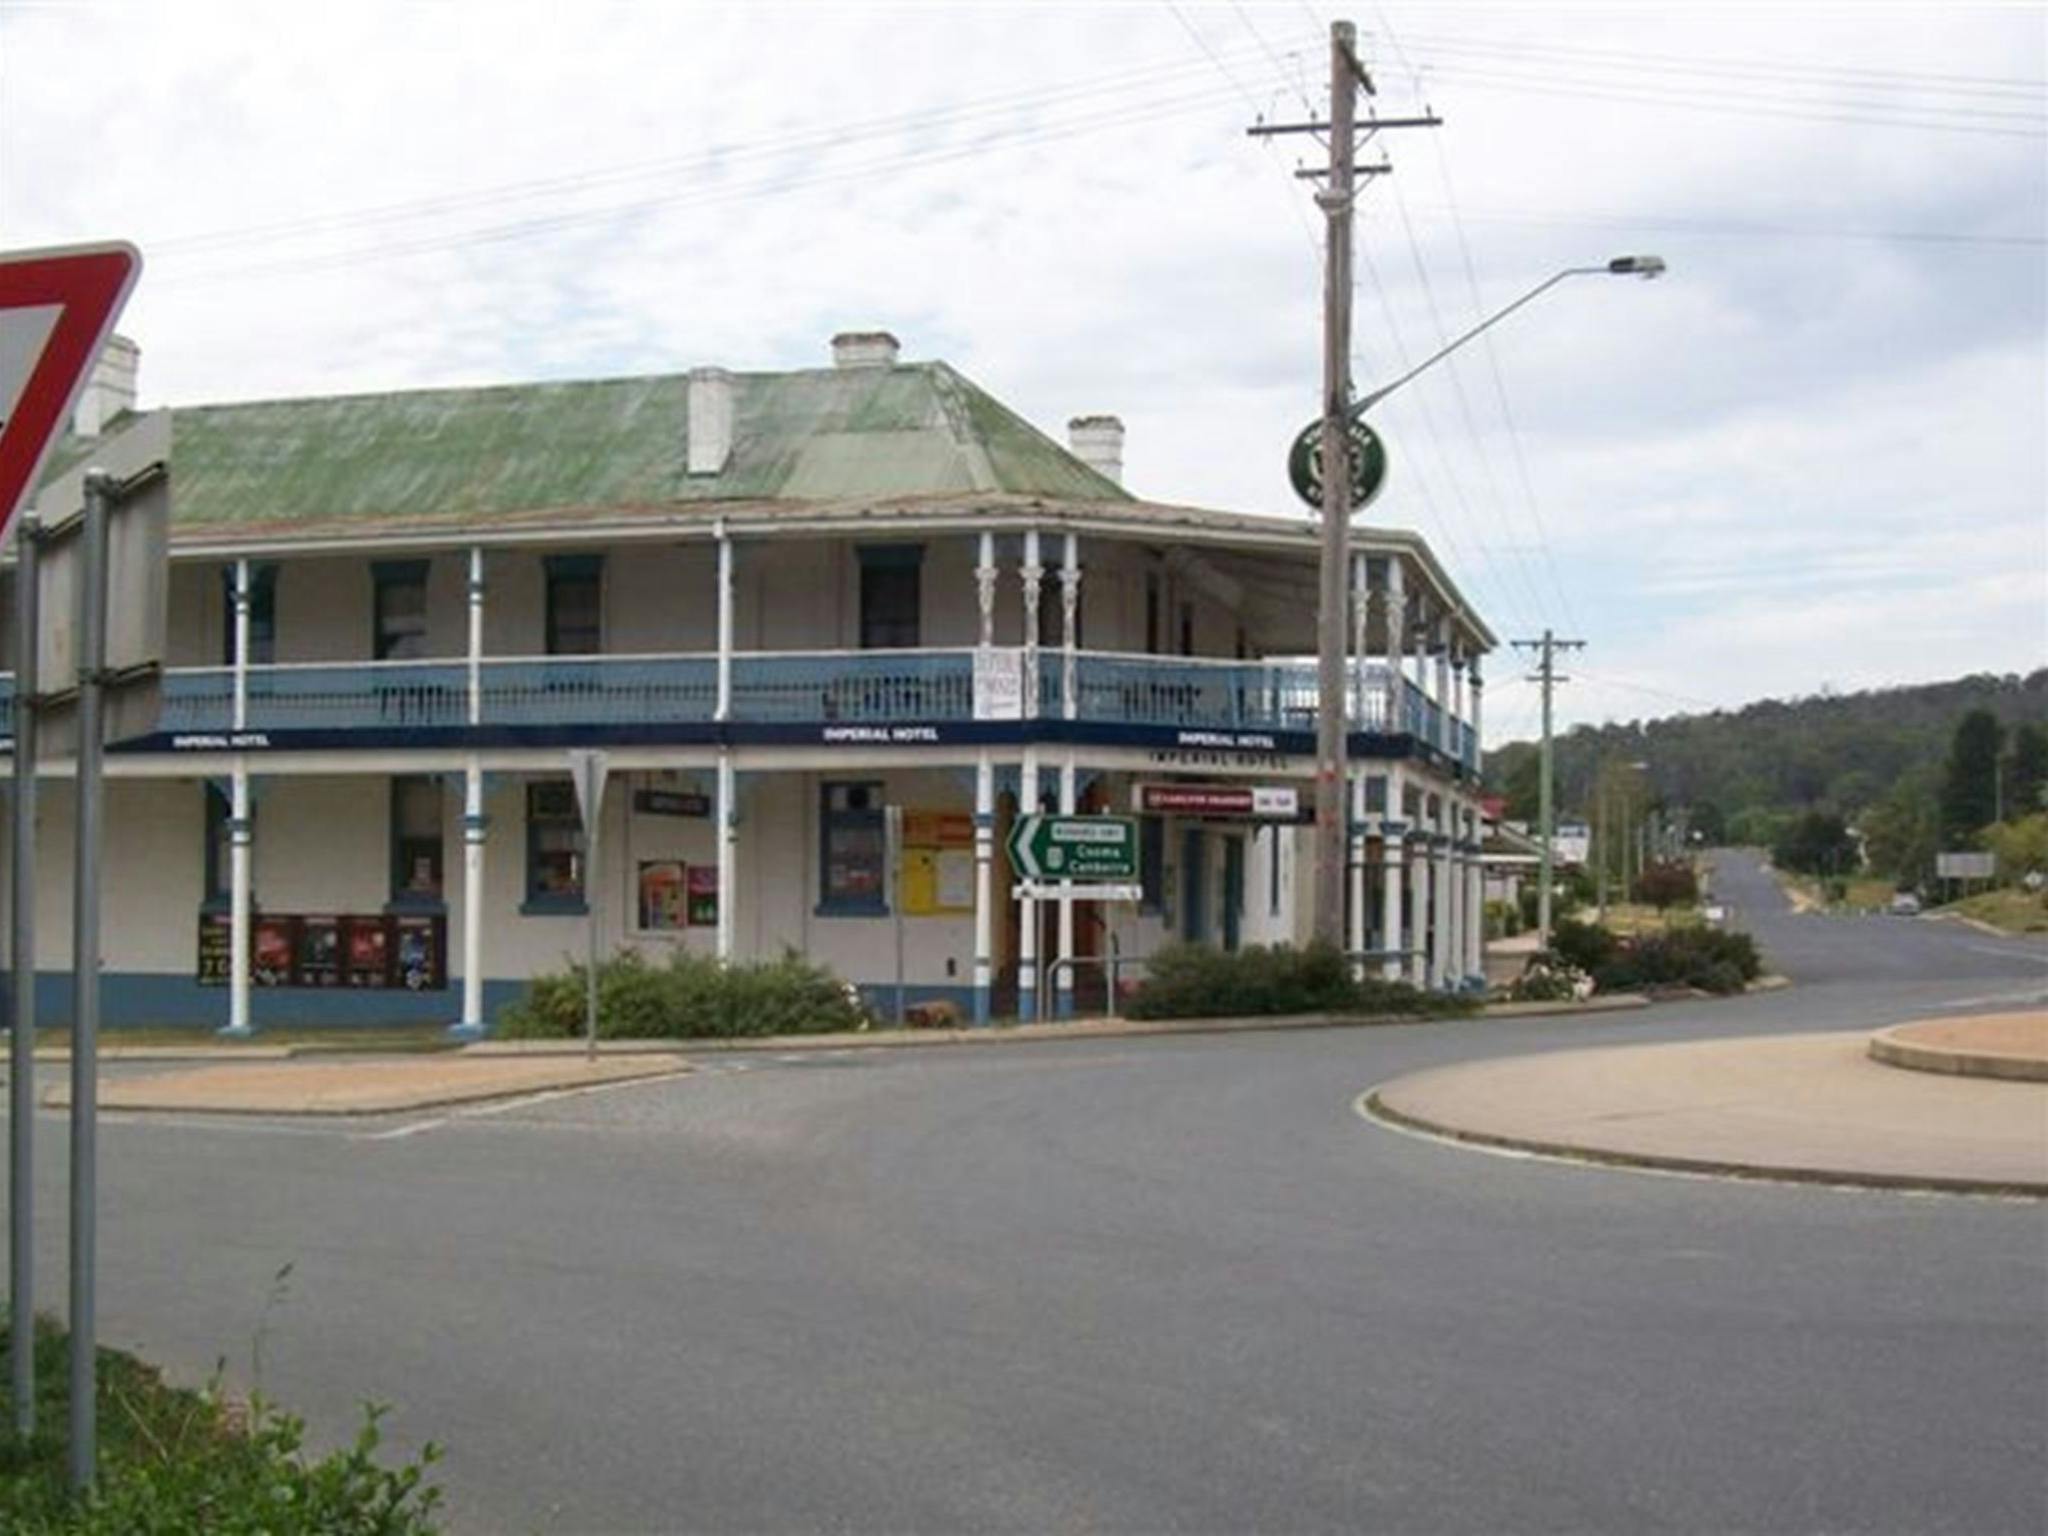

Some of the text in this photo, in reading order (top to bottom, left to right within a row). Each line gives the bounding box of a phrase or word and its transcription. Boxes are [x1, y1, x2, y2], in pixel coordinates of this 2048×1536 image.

[231, 734, 270, 746] HOTEL
[824, 728, 938, 740] IMPERIAL HOTEL
[1177, 731, 1275, 748] IMPERIAL HOTEL
[1075, 843, 1121, 859] Cooma
[1068, 859, 1130, 874] Canberra
